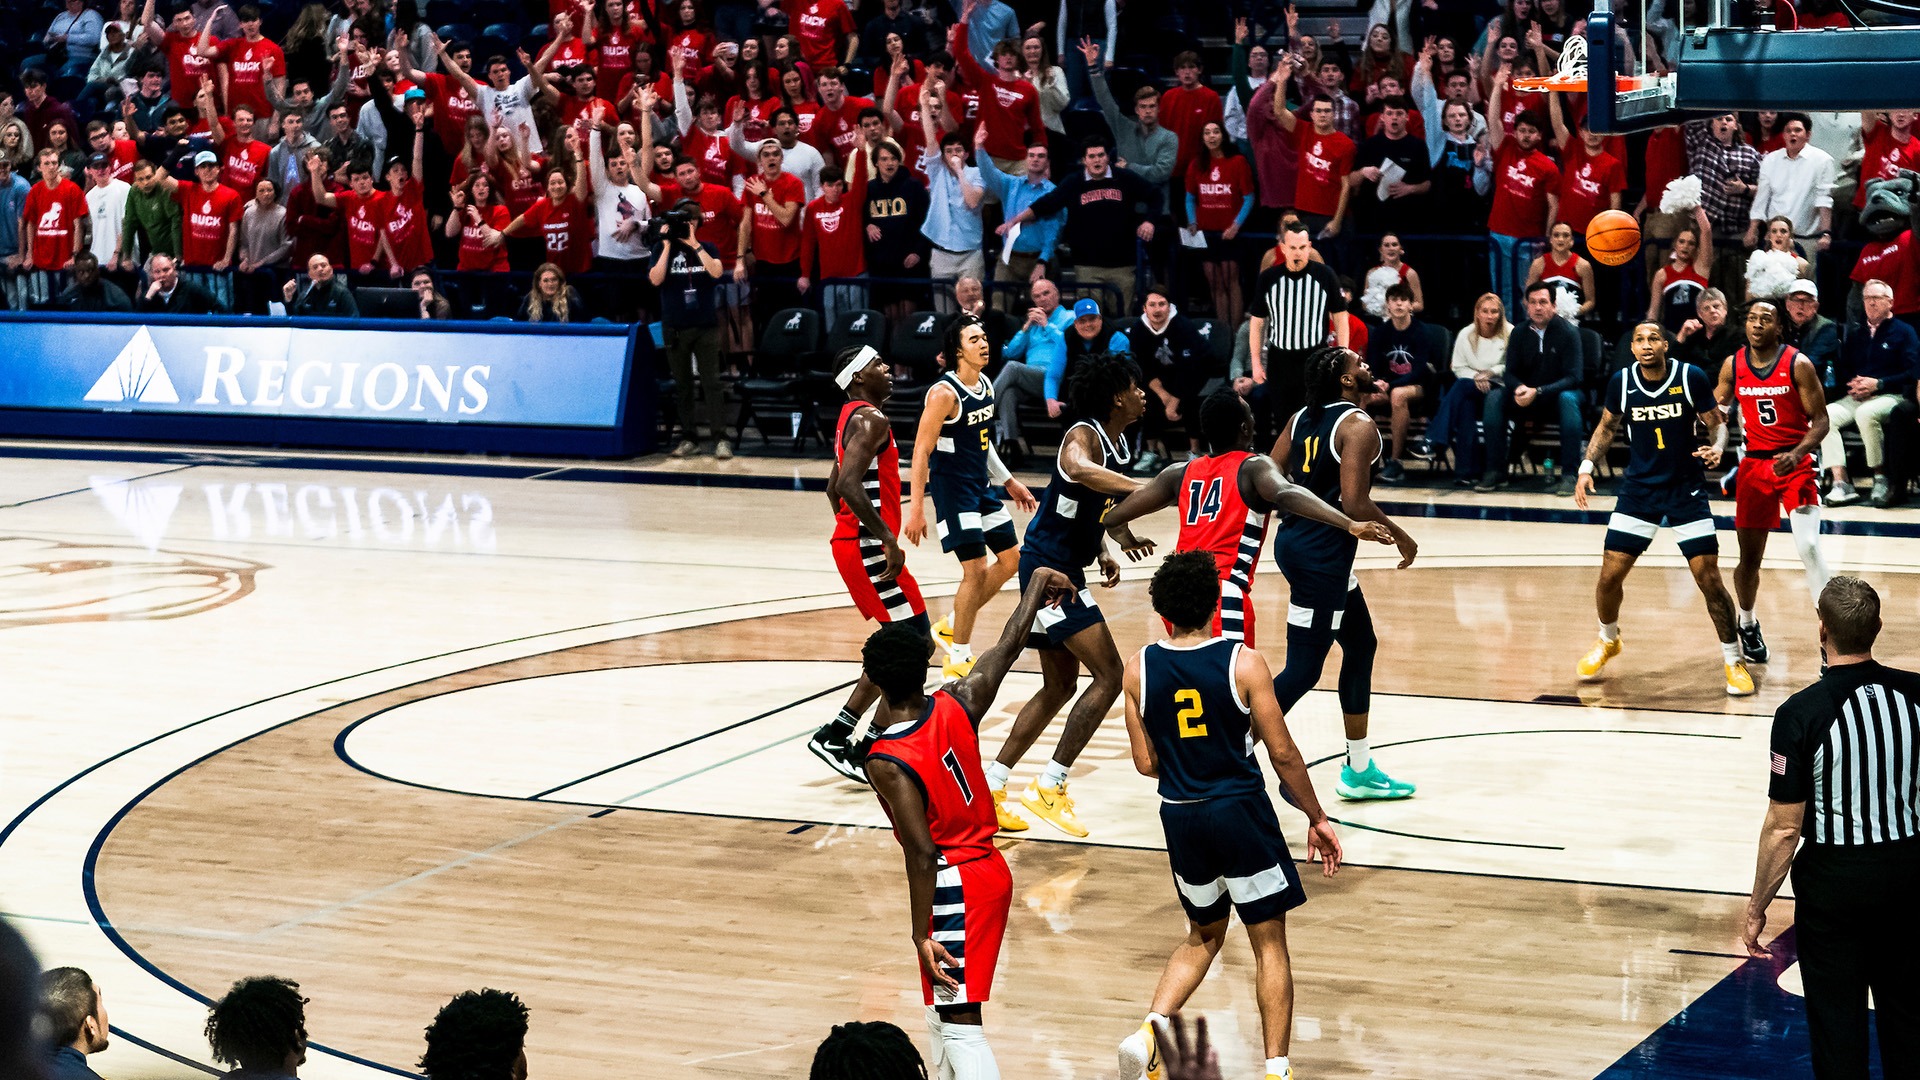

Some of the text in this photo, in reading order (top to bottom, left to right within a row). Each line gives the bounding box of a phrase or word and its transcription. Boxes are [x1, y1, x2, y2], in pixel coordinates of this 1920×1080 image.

[800, 13, 826, 27] BUCK
[602, 45, 630, 55] BUCK
[233, 61, 262, 72] BUCK
[229, 156, 259, 174] BUCK
[1080, 188, 1123, 206] SAMFORD
[1199, 183, 1232, 195] BUCK
[190, 212, 221, 227] BUCK
[463, 226, 484, 239] BUC
[547, 232, 569, 251] 22
[194, 344, 491, 415] REGIONS
[1738, 385, 1790, 397] SAMFORD
[1630, 402, 1682, 422] ETSU
[1756, 399, 1779, 426] 5
[979, 428, 989, 451] 5
[1654, 427, 1666, 450] 1
[1302, 435, 1320, 473] 11
[1186, 475, 1223, 526] 14
[1173, 688, 1209, 739] 2
[941, 746, 974, 807] 1
